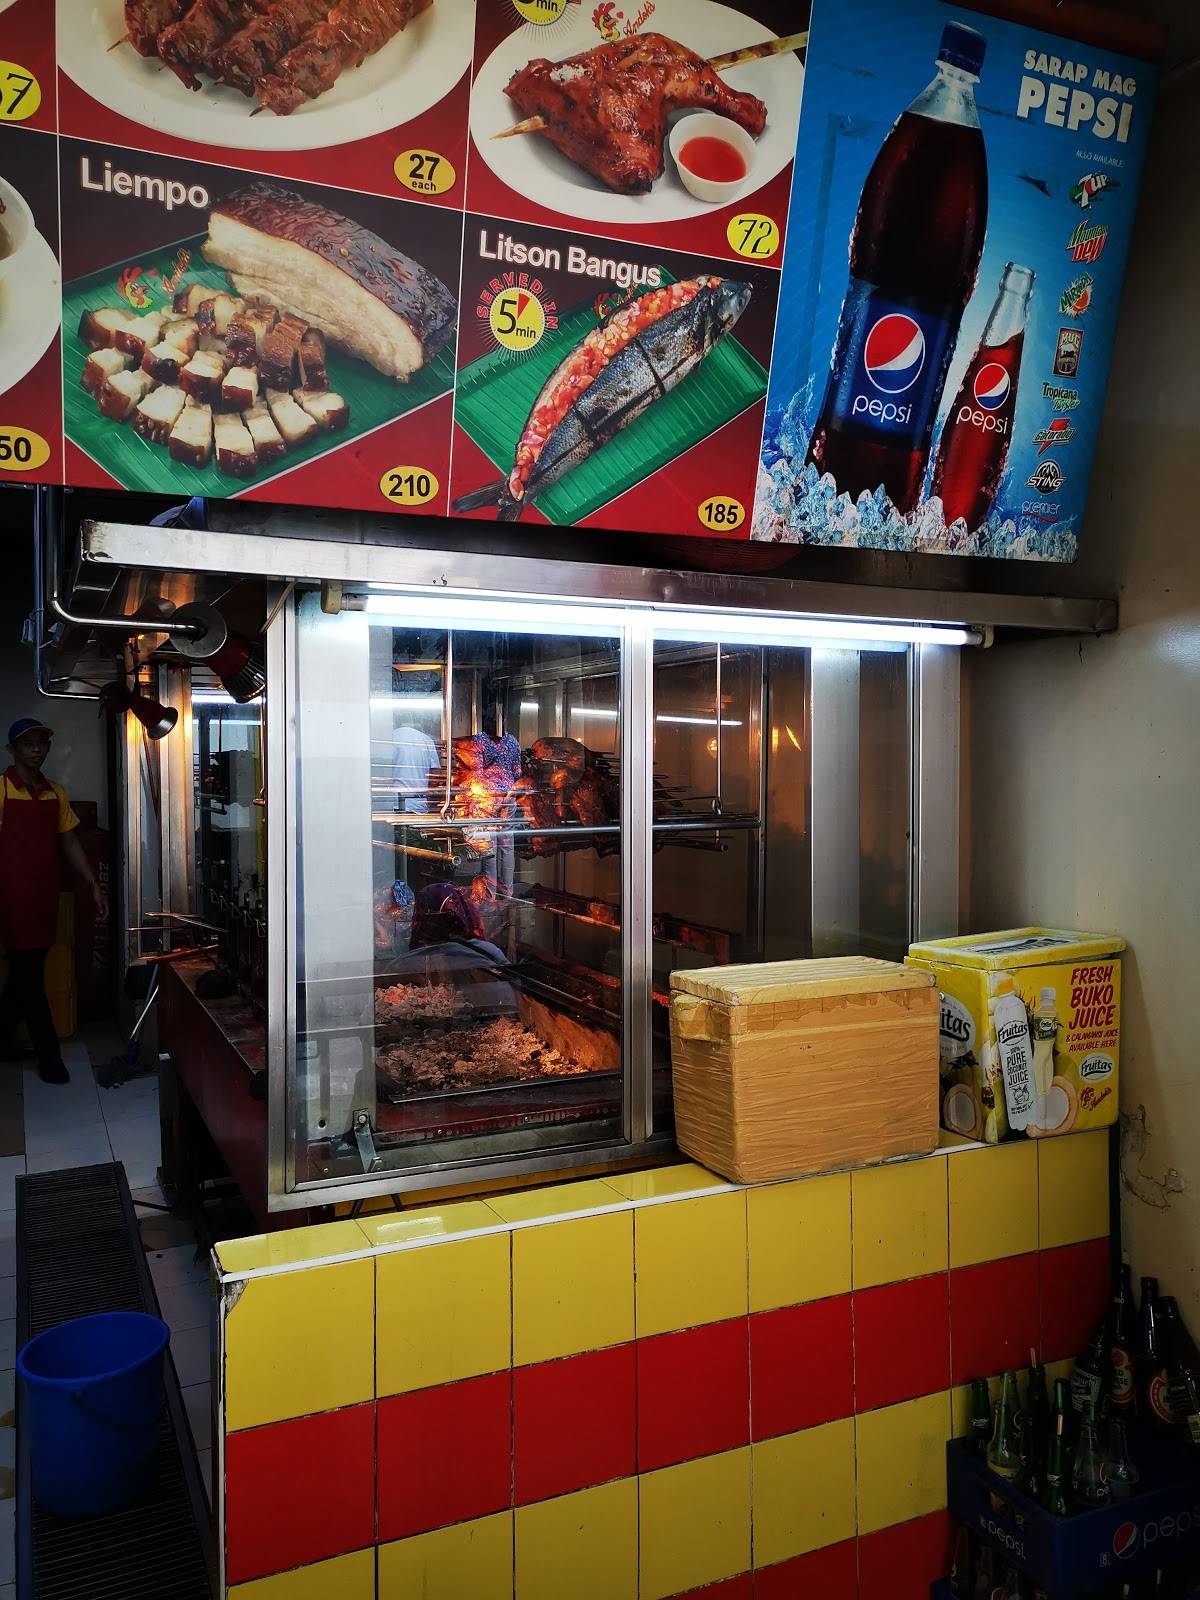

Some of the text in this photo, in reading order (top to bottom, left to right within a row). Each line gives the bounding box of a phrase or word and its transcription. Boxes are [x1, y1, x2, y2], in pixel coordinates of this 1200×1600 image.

[1024, 49, 1137, 97] SARAP MAG
[0, 73, 33, 114] 7
[1017, 75, 1133, 143] PEPSI
[409, 153, 440, 181] 27
[81, 157, 209, 211] Liempo
[411, 181, 437, 191] each
[738, 219, 772, 255] 72
[479, 230, 661, 288] Litson Bangus
[477, 271, 559, 329] SERVED IN
[497, 299, 537, 339] 5 min
[1042, 381, 1078, 399] Tropicana
[852, 395, 913, 424] pepsi
[956, 406, 1009, 435] pepsi
[0, 435, 32, 462] 50
[388, 474, 431, 497] 210
[1027, 476, 1065, 488] STING
[704, 502, 738, 524] 185
[1070, 965, 1114, 985] FRESH
[1070, 984, 1114, 1008] BUKO
[1069, 1005, 1116, 1029] JUICE
[998, 1022, 1029, 1044] Fruitas
[1007, 1051, 1027, 1068] PURE
[1081, 1060, 1112, 1077] Fruitas
[1009, 1070, 1029, 1086] JUICE
